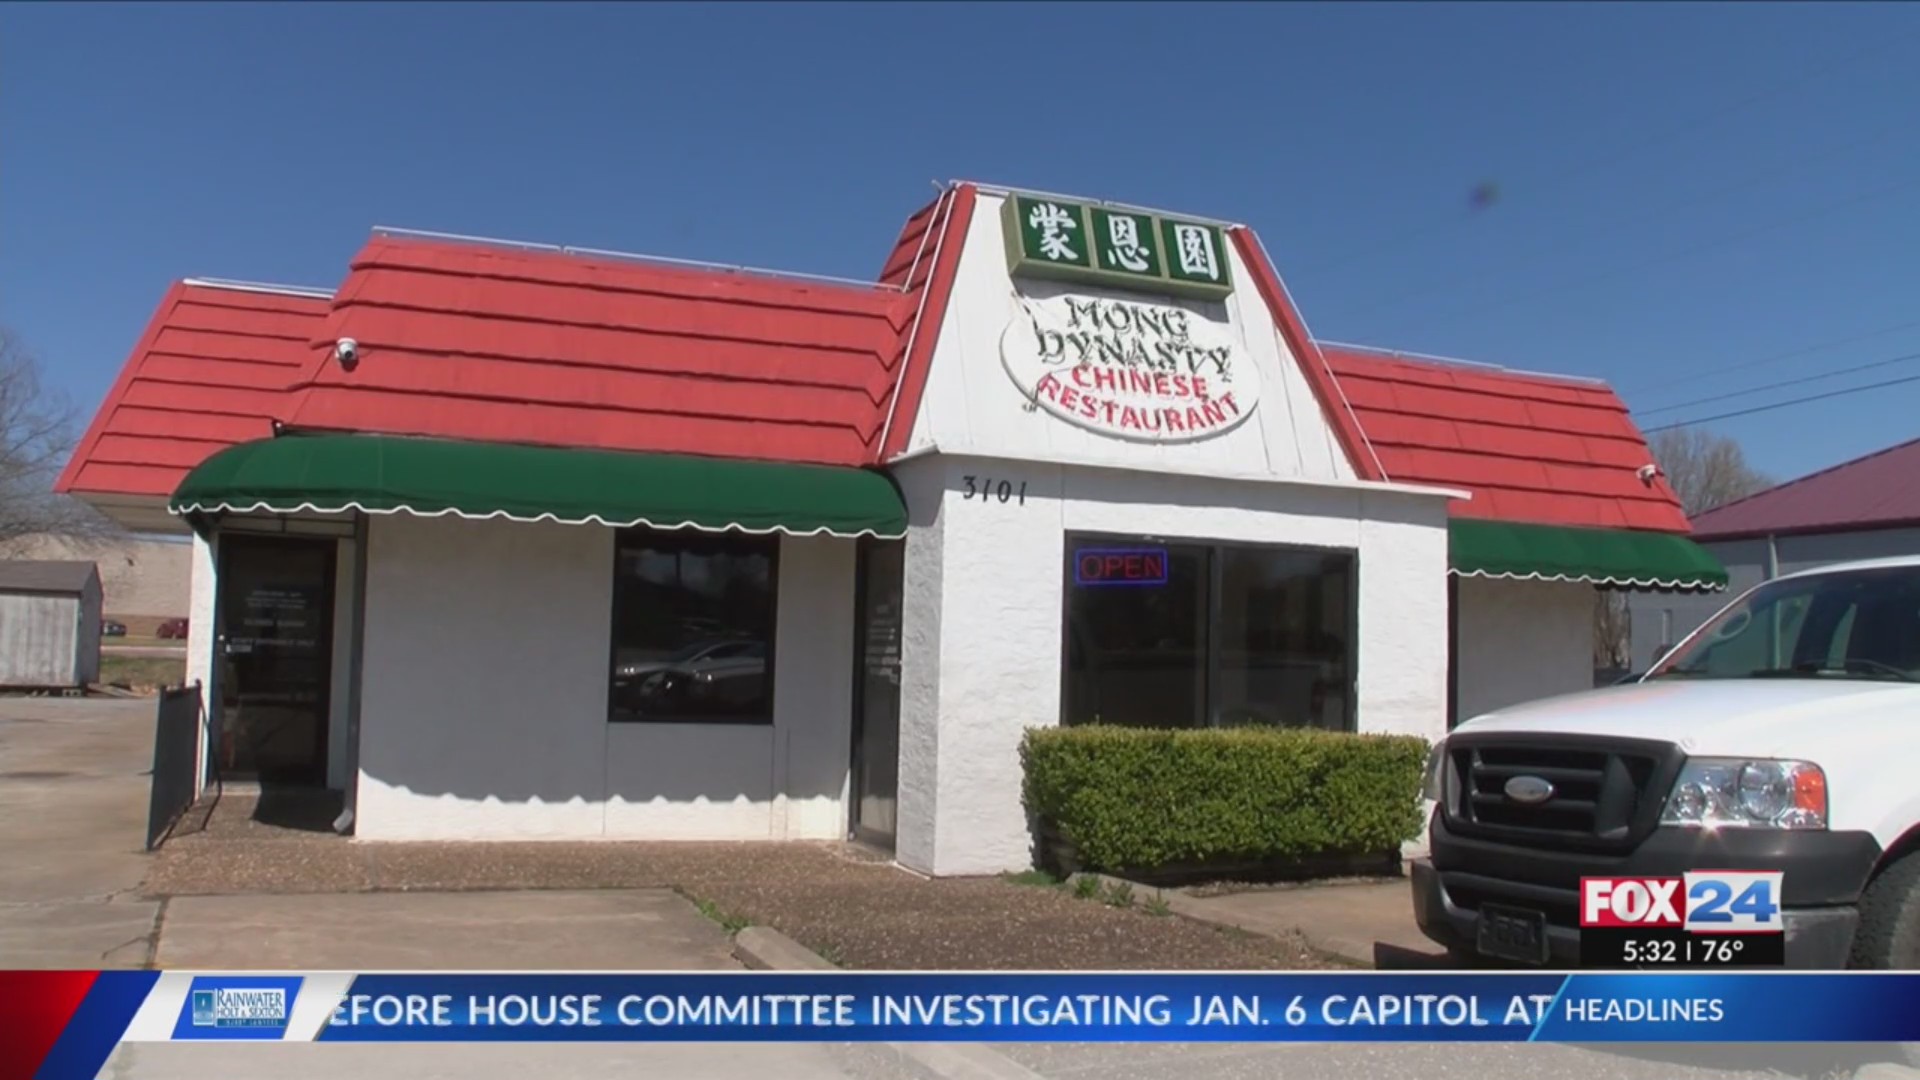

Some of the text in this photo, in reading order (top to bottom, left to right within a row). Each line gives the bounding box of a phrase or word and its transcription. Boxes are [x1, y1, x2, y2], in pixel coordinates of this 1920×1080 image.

[1064, 296, 1188, 340] MONG
[1036, 329, 1231, 375] DYNASTY
[1037, 372, 1241, 432] RESTAURANT
[1071, 363, 1208, 402] CHINESE
[963, 475, 1027, 506] 3101
[1080, 554, 1163, 579] OPEN
